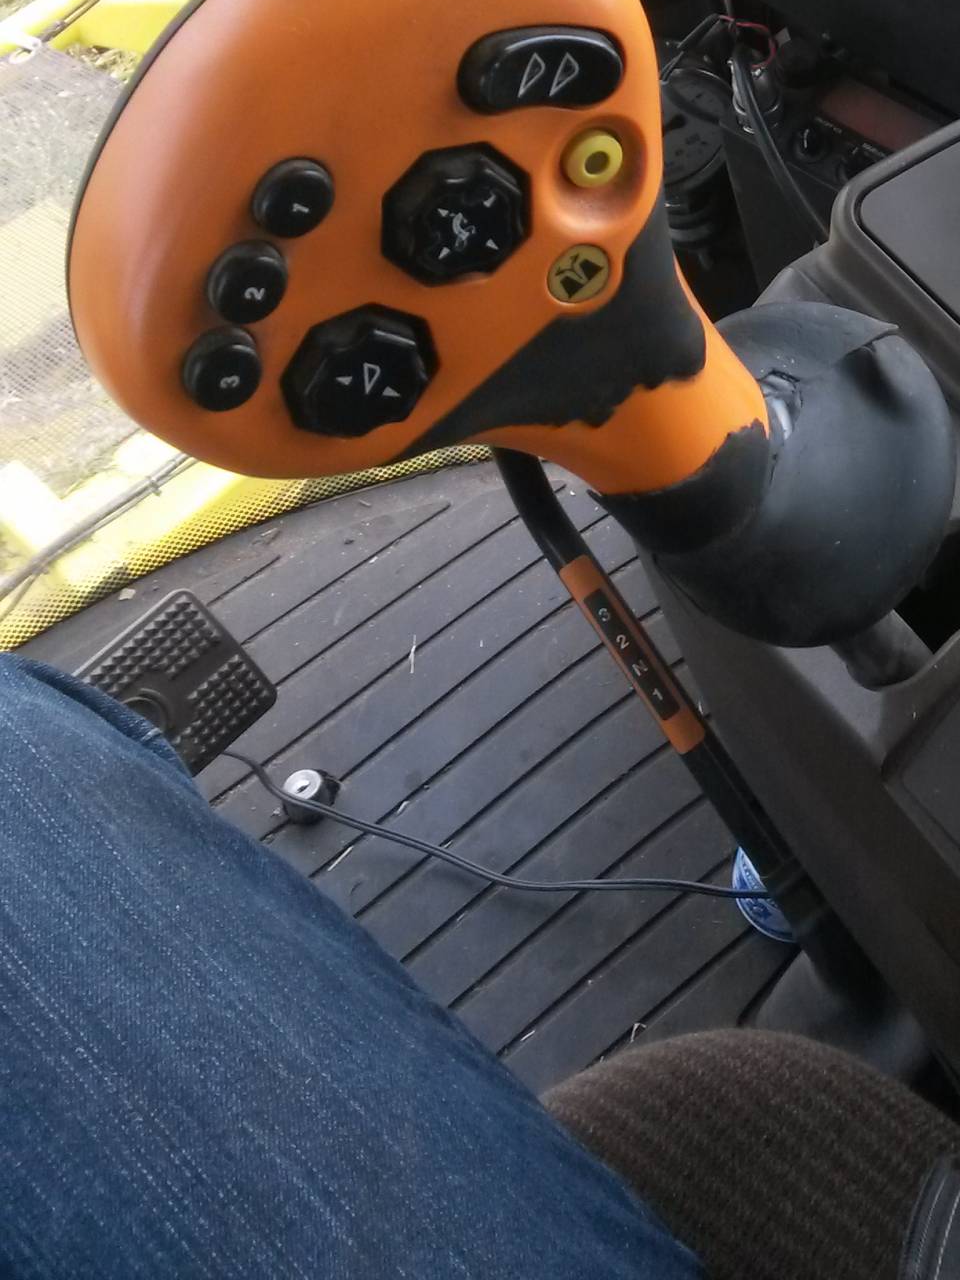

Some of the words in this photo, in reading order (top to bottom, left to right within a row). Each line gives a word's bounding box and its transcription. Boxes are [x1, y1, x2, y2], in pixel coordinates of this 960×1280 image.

[292, 203, 310, 213] 1
[244, 287, 265, 301] 2
[220, 375, 240, 389] 3
[616, 634, 630, 649] 2
[652, 688, 663, 701] 1
